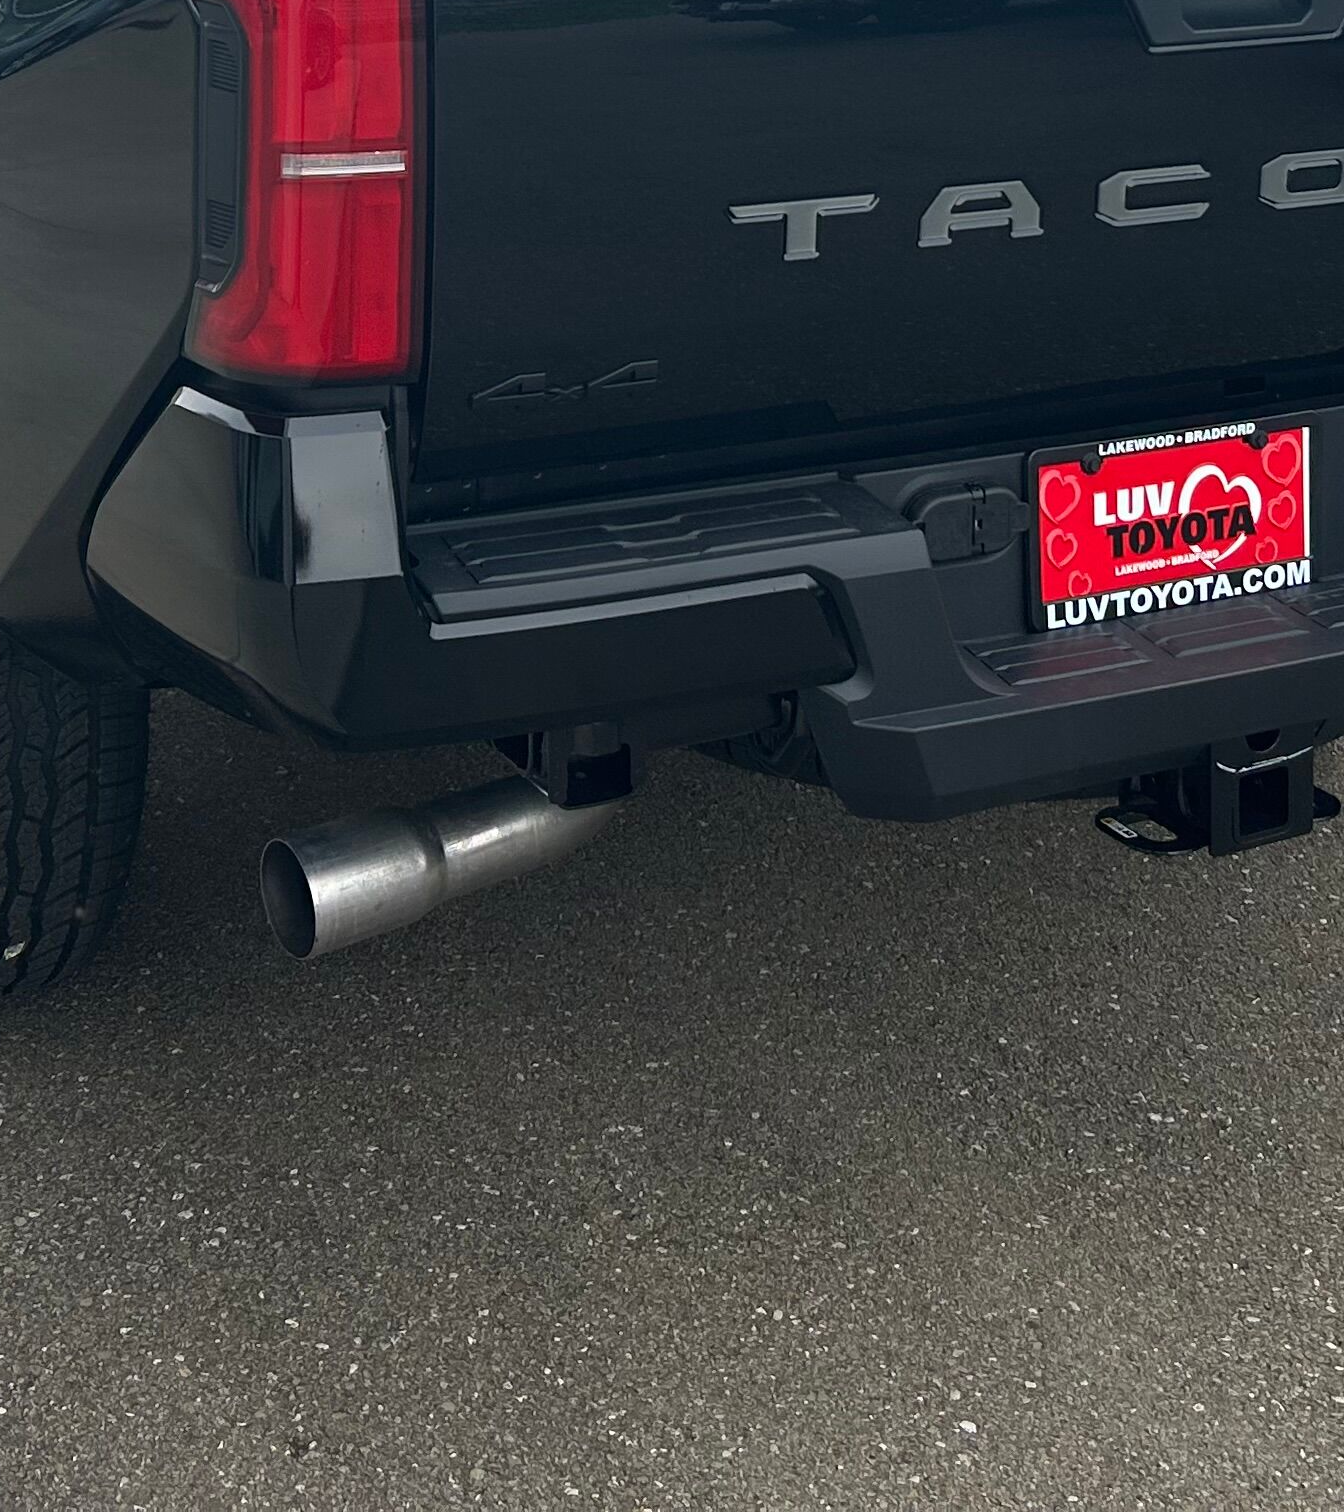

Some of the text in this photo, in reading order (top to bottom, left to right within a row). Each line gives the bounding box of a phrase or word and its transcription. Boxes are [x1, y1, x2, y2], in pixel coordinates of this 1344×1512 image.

[1098, 422, 1256, 456] LAKEWOOD BRADFORD
[1092, 480, 1175, 527] LUV
[1106, 504, 1255, 558] TOYOTA
[1114, 549, 1220, 576] LAKEWOOD BRADFORD
[1047, 560, 1311, 630] LUVTOYOTA.COM
